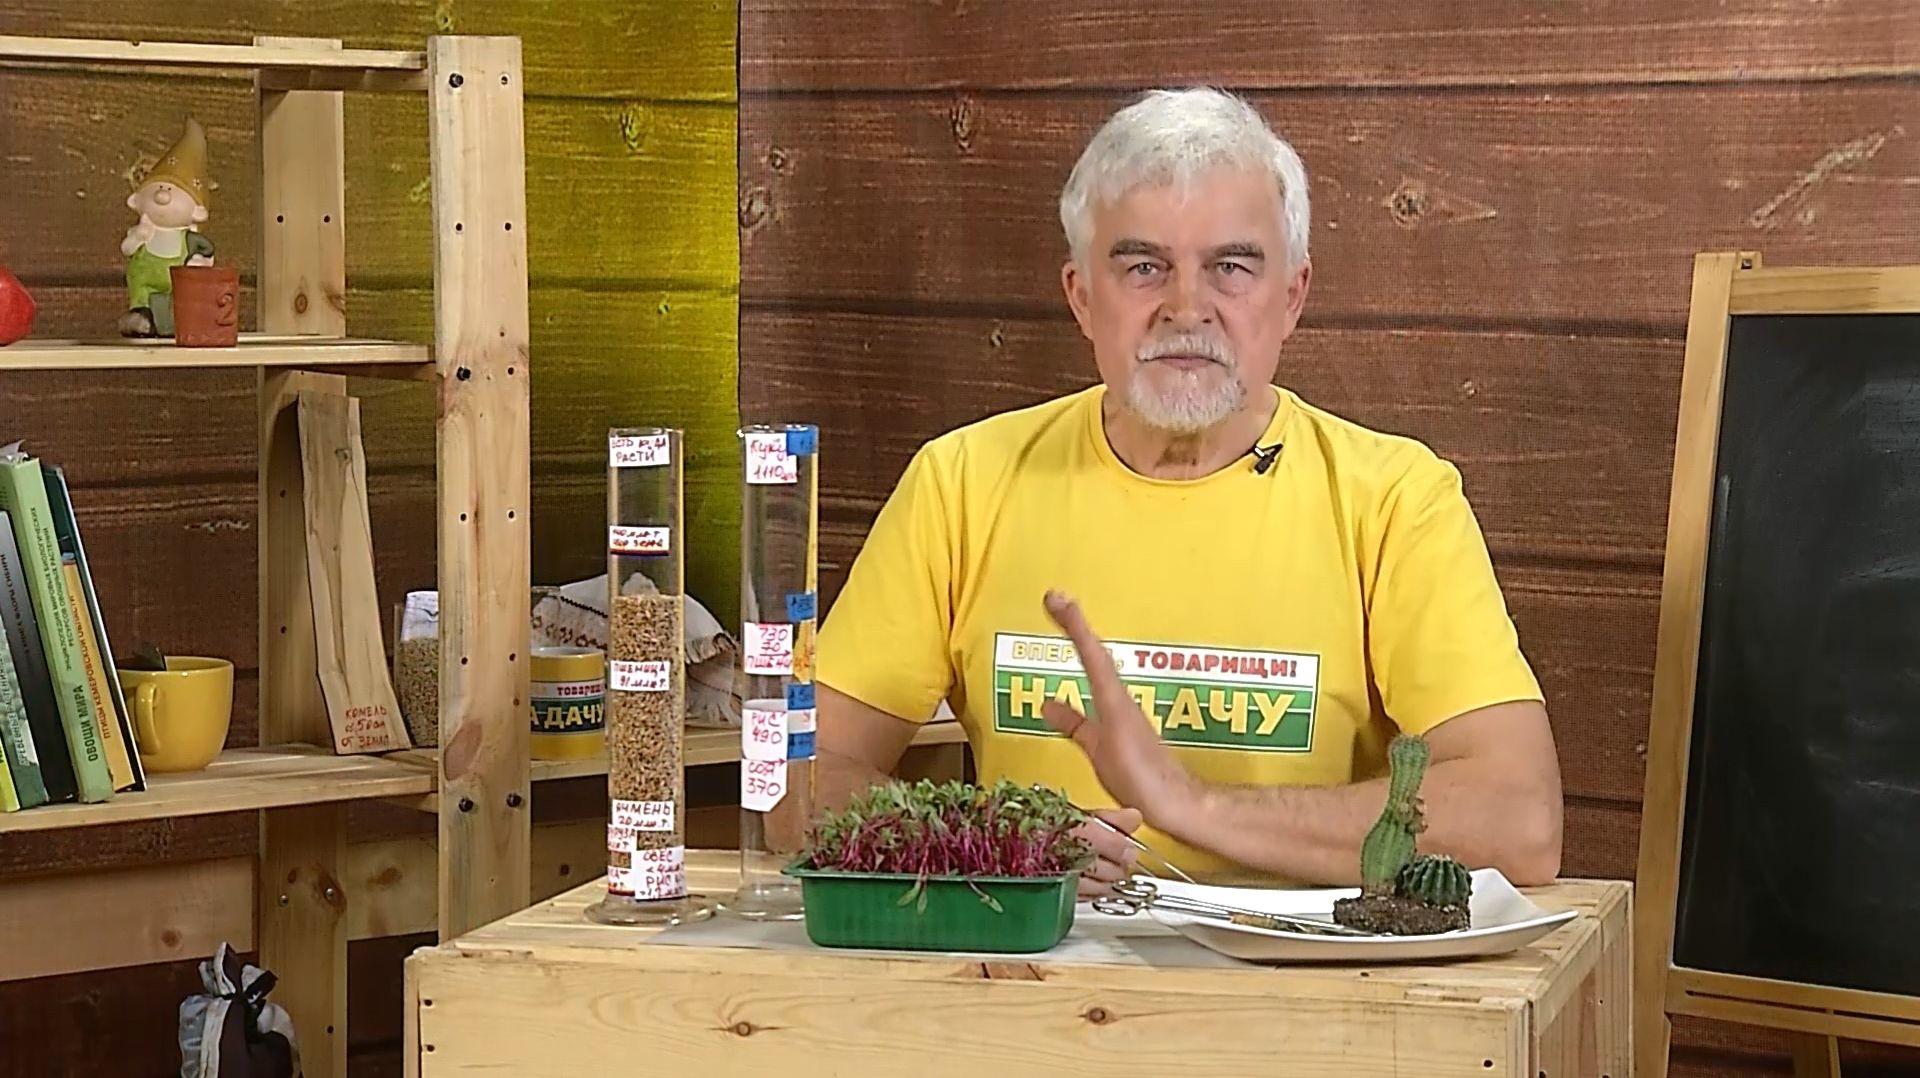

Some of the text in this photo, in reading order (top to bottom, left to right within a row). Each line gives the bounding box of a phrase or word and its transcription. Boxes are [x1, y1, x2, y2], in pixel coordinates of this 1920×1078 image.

[216, 292, 235, 327] 2
[615, 449, 655, 463] РАСТИ
[79, 638, 102, 706] КЕМЕРОВСКОЙ
[1134, 649, 1298, 679] ТОВАРИЩИ!
[1009, 675, 1086, 719] НА
[73, 685, 99, 762] ОВОЩИ МИРА
[96, 707, 111, 738] ПТИЦЫ
[345, 704, 387, 720] КОМЕЛЬ
[544, 703, 605, 729] ДАЧУ
[752, 712, 780, 727] РИС
[752, 726, 783, 744] 490
[747, 777, 781, 796] 370
[615, 802, 671, 816] ЯЧМЕНЬ
